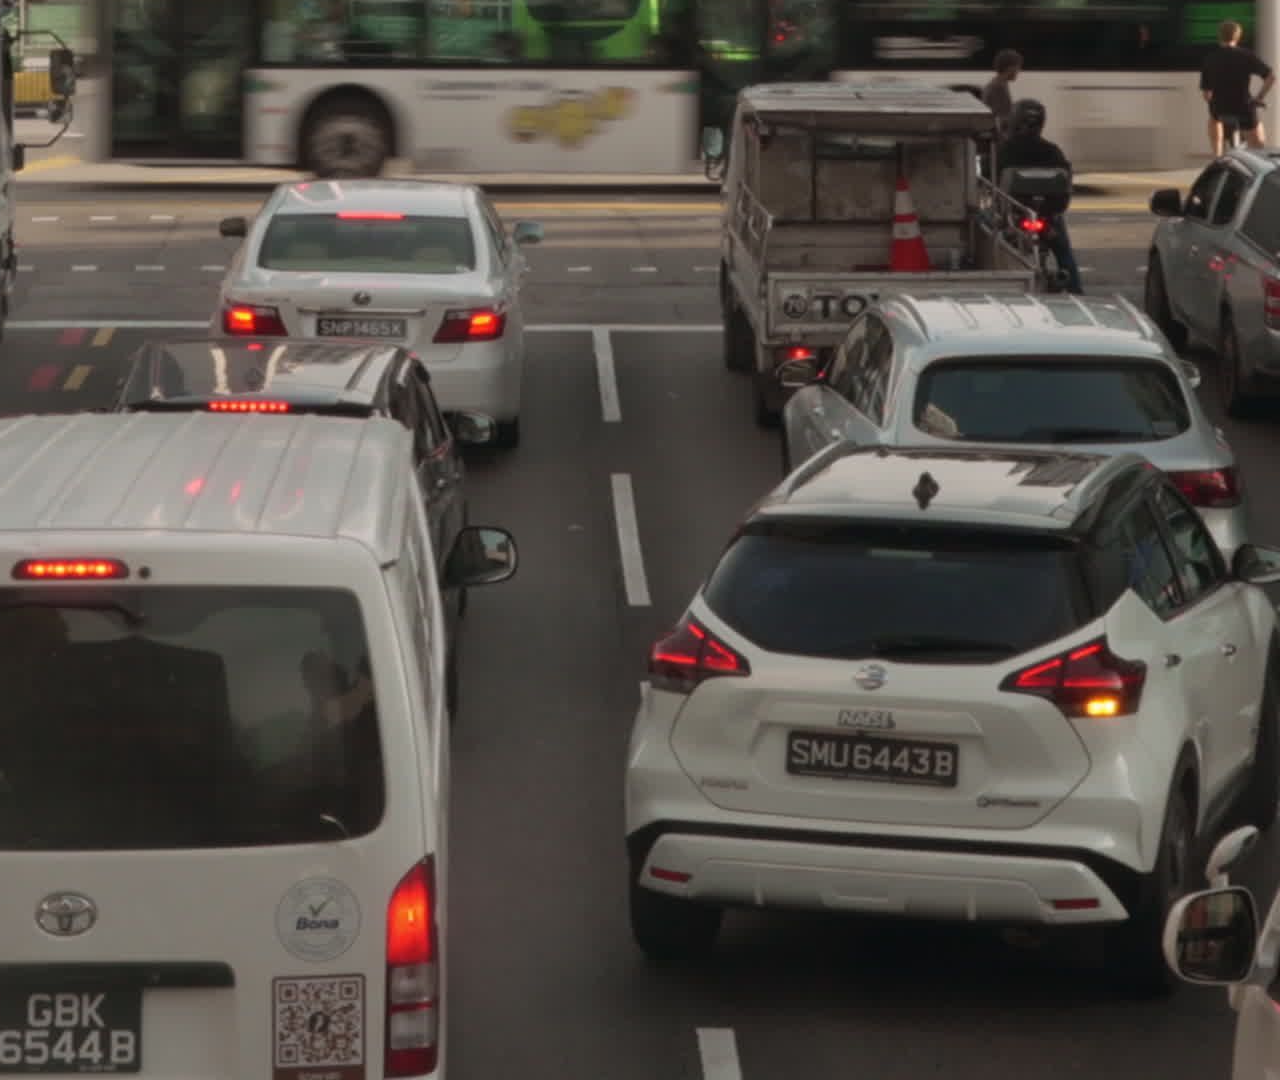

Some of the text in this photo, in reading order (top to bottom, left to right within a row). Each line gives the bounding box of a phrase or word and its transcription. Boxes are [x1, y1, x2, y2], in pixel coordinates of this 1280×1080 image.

[791, 739, 954, 778] SMU6443B
[296, 916, 340, 931] Bona
[27, 992, 106, 1029] GBK
